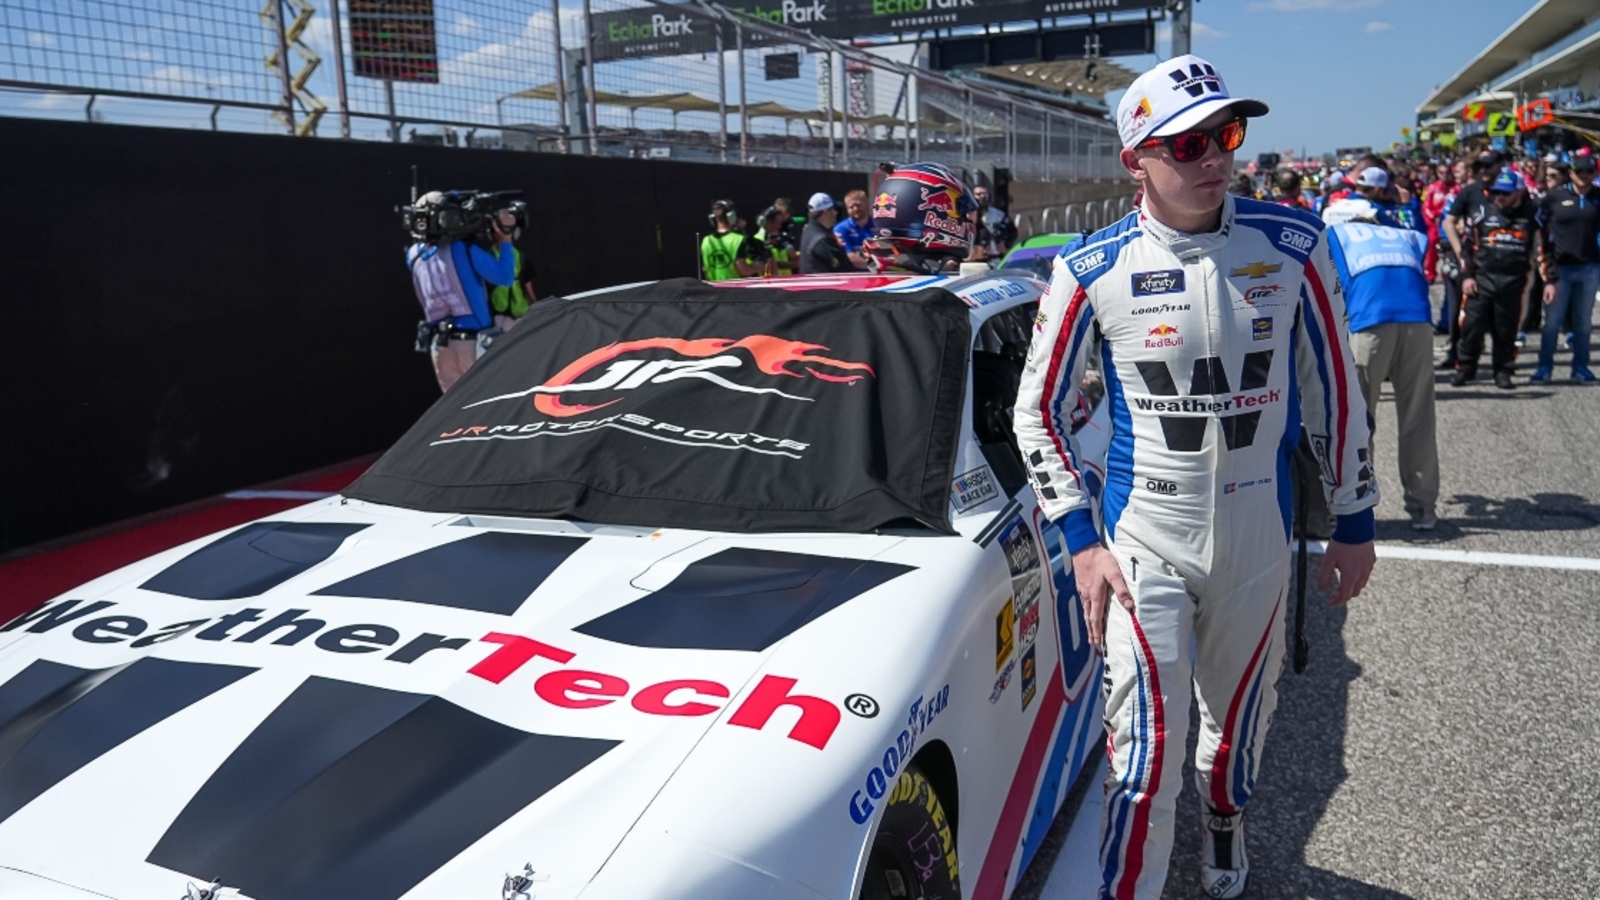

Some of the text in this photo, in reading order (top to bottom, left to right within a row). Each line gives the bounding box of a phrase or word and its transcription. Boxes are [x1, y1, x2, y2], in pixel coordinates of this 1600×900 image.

[608, 14, 693, 42] EchoPark
[890, 13, 957, 27] AUTOMOTIVE
[924, 211, 948, 231] Red
[1281, 231, 1312, 249] OMP
[1074, 252, 1105, 272] OMP
[1140, 278, 1177, 291] xfinity
[1131, 304, 1191, 316] GOODYEAR
[1145, 336, 1184, 348] Red Bull
[1134, 390, 1279, 413] WeatherTech
[961, 483, 993, 505] RACE CAR
[1146, 480, 1177, 493] OMP
[849, 684, 950, 825] GOODYEAR
[888, 771, 958, 881] ODYEAR
[1211, 875, 1233, 897] OMP
